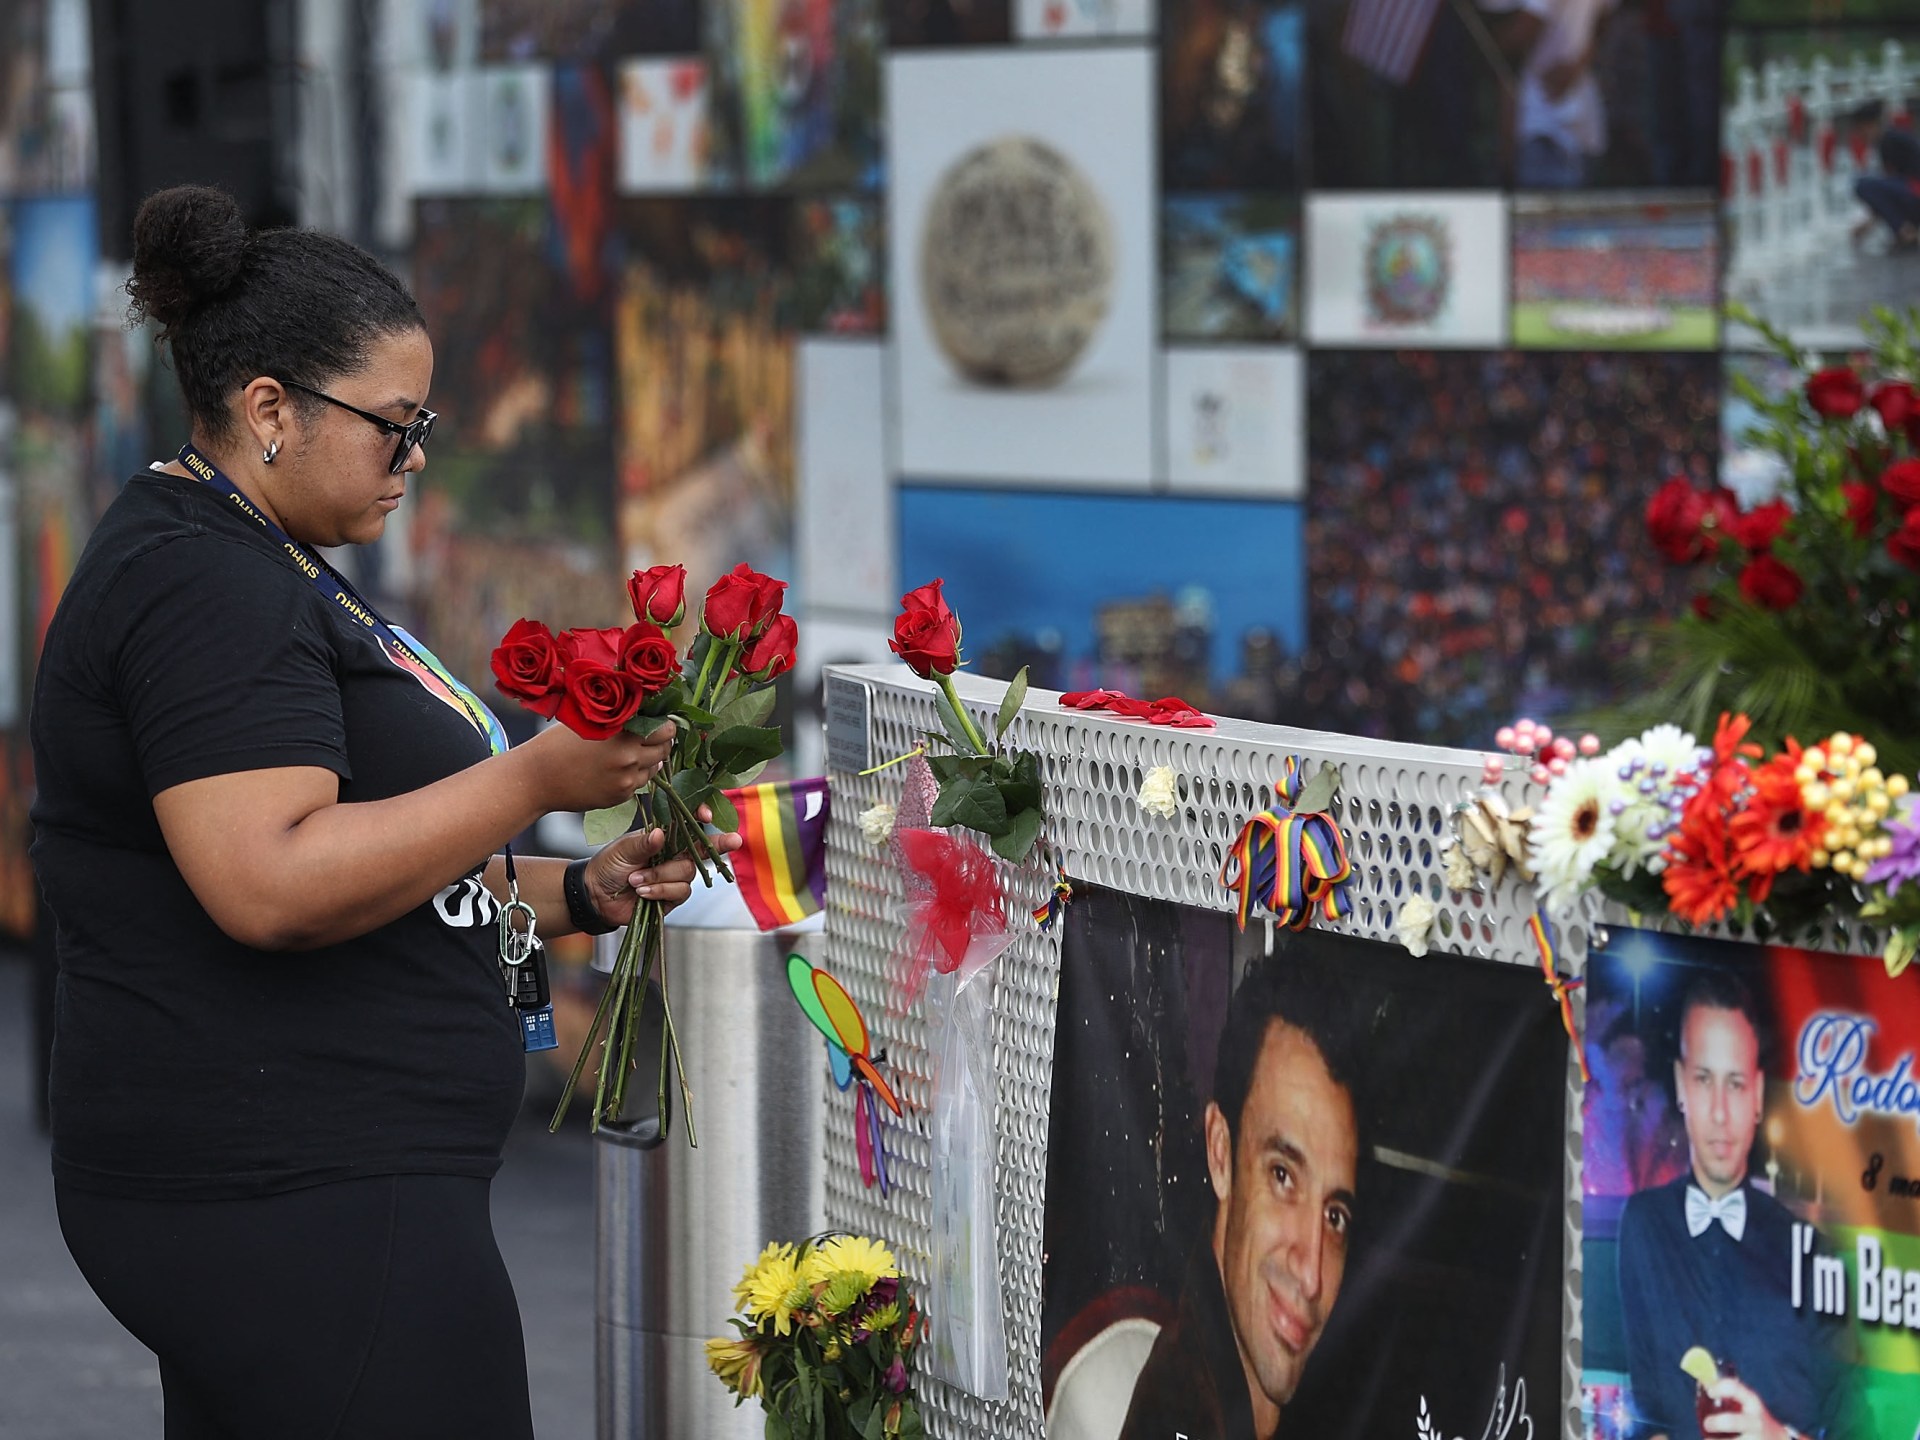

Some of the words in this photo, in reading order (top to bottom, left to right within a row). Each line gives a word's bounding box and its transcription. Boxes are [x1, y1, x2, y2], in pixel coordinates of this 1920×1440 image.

[184, 453, 215, 481] SNHU
[283, 543, 320, 579] SNHU
[335, 592, 375, 627] SNHU
[1861, 1153, 1884, 1192] 8
[1791, 1222, 1845, 1316] I'm
[1857, 1233, 1920, 1329] Bea
